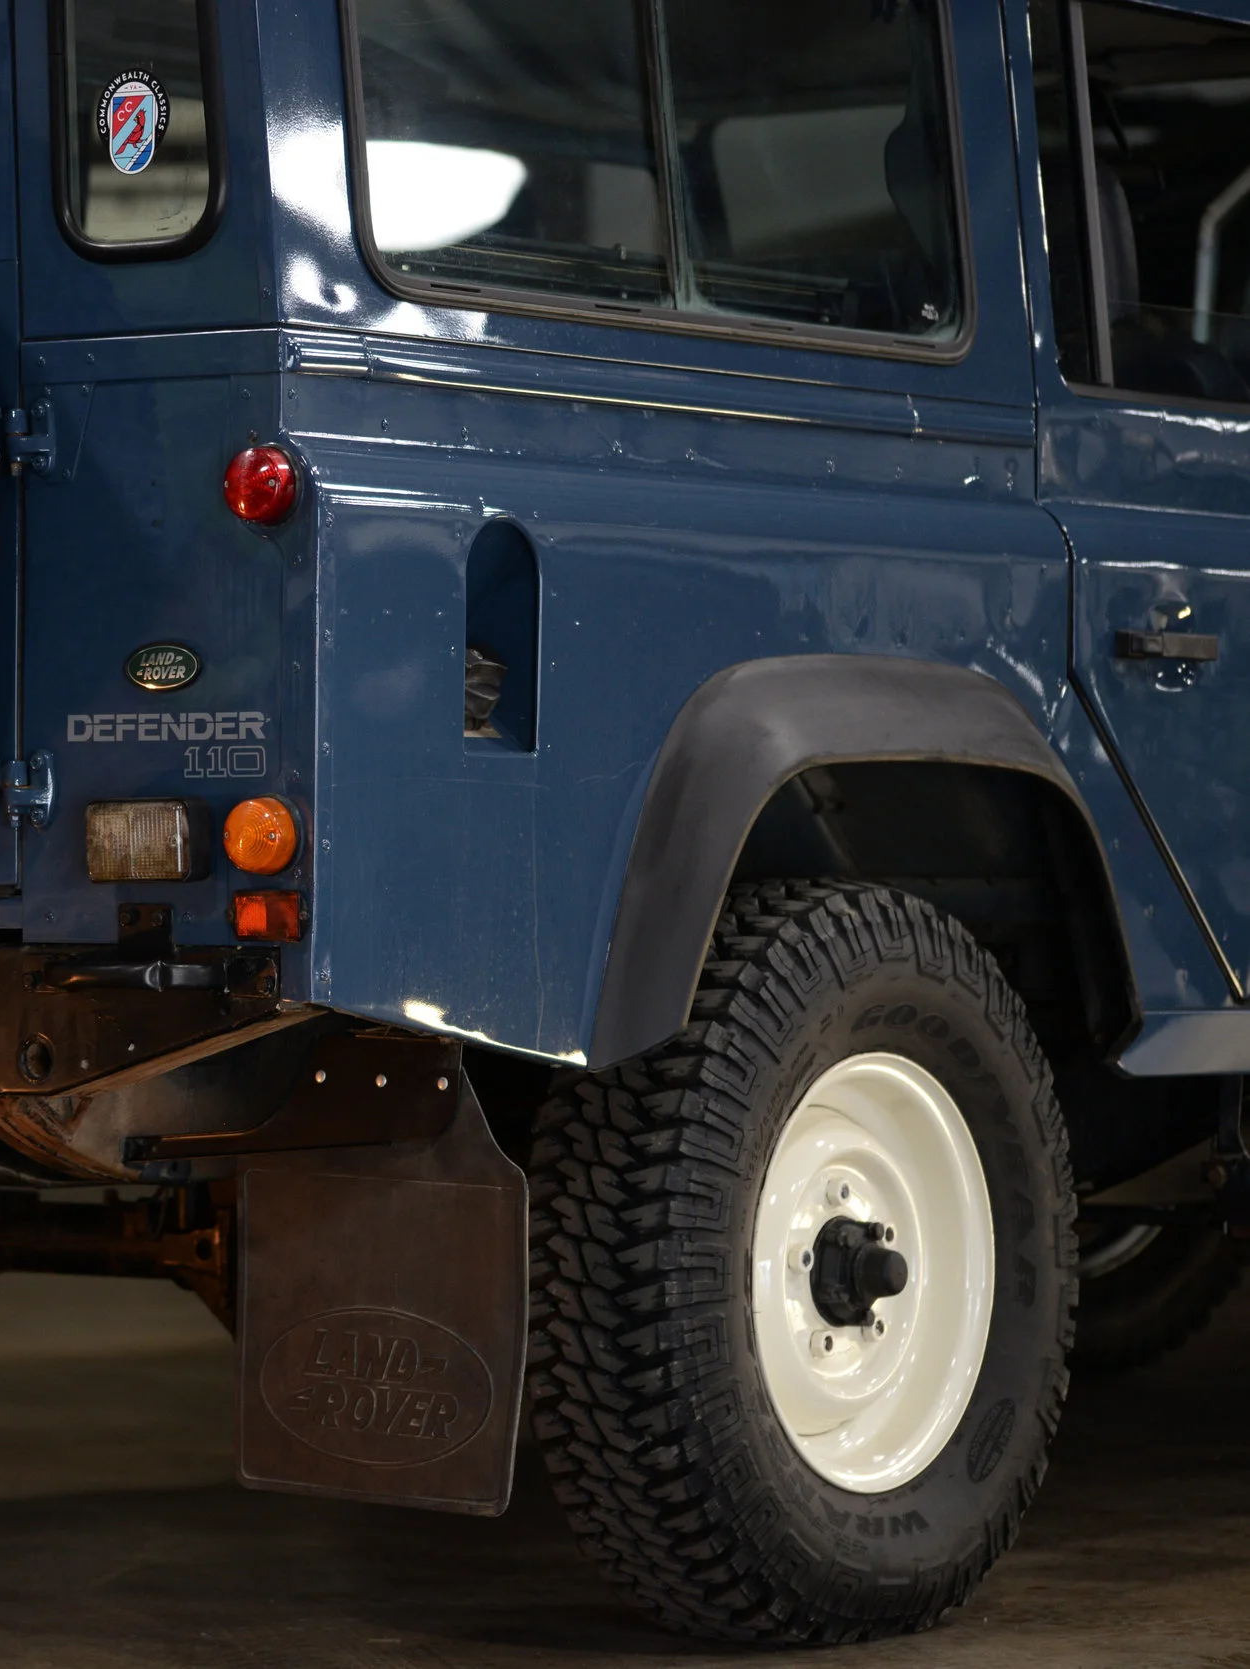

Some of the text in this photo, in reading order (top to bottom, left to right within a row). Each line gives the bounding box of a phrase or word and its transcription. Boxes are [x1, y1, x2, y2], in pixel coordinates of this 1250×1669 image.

[99, 71, 167, 134] COMMONWEALTH CLASSICS
[139, 652, 176, 667] LAND
[143, 665, 187, 681] ROVER
[66, 711, 266, 742] DEFENDER
[184, 745, 267, 778] 110
[302, 1328, 420, 1384] LAND
[312, 1381, 460, 1440] ROVER
